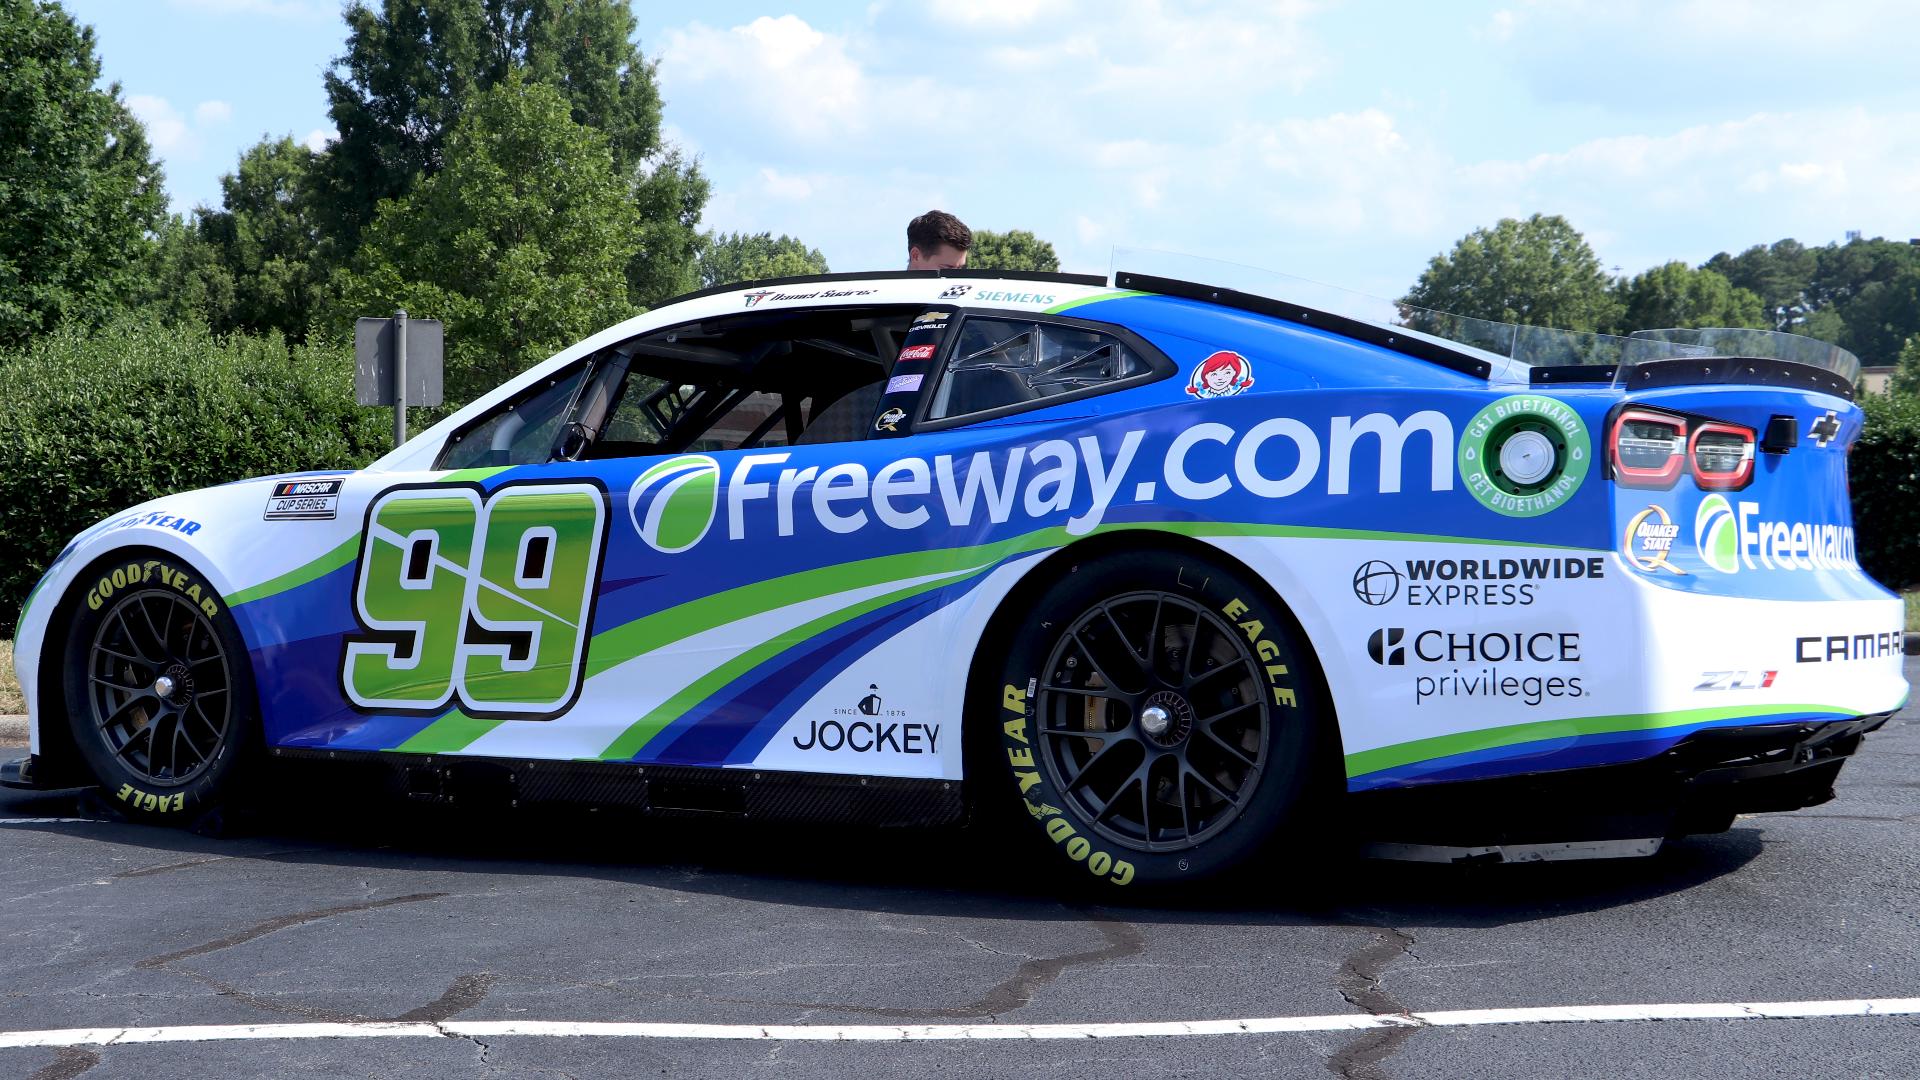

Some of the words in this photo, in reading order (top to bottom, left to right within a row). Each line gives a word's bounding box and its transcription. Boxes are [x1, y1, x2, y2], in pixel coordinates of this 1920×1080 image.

[974, 290, 1056, 305] SIEMENS
[908, 323, 948, 333] CHEVROLET
[1470, 413, 1494, 438] GET
[1494, 400, 1581, 439] BIOETHANOL
[728, 410, 1454, 541] Freeway.com
[293, 482, 334, 495] NASCAR
[1469, 472, 1493, 496] GET
[1491, 474, 1577, 512] BIOETHANOL
[276, 499, 296, 511] CUP
[295, 498, 328, 510] SERIES
[1637, 521, 1680, 538] QUAKER
[1642, 536, 1672, 551] STATE
[1406, 557, 1604, 580] WORLDWIDE
[339, 477, 612, 720] 99
[1407, 584, 1535, 605] EXPRESS
[1222, 597, 1297, 708] EAGLE
[1414, 629, 1581, 662] CHOICE
[1693, 670, 1778, 692] ZL1
[834, 708, 857, 716] SINCE
[793, 720, 940, 754] JOCKEY
[116, 783, 185, 813] EAGLE
